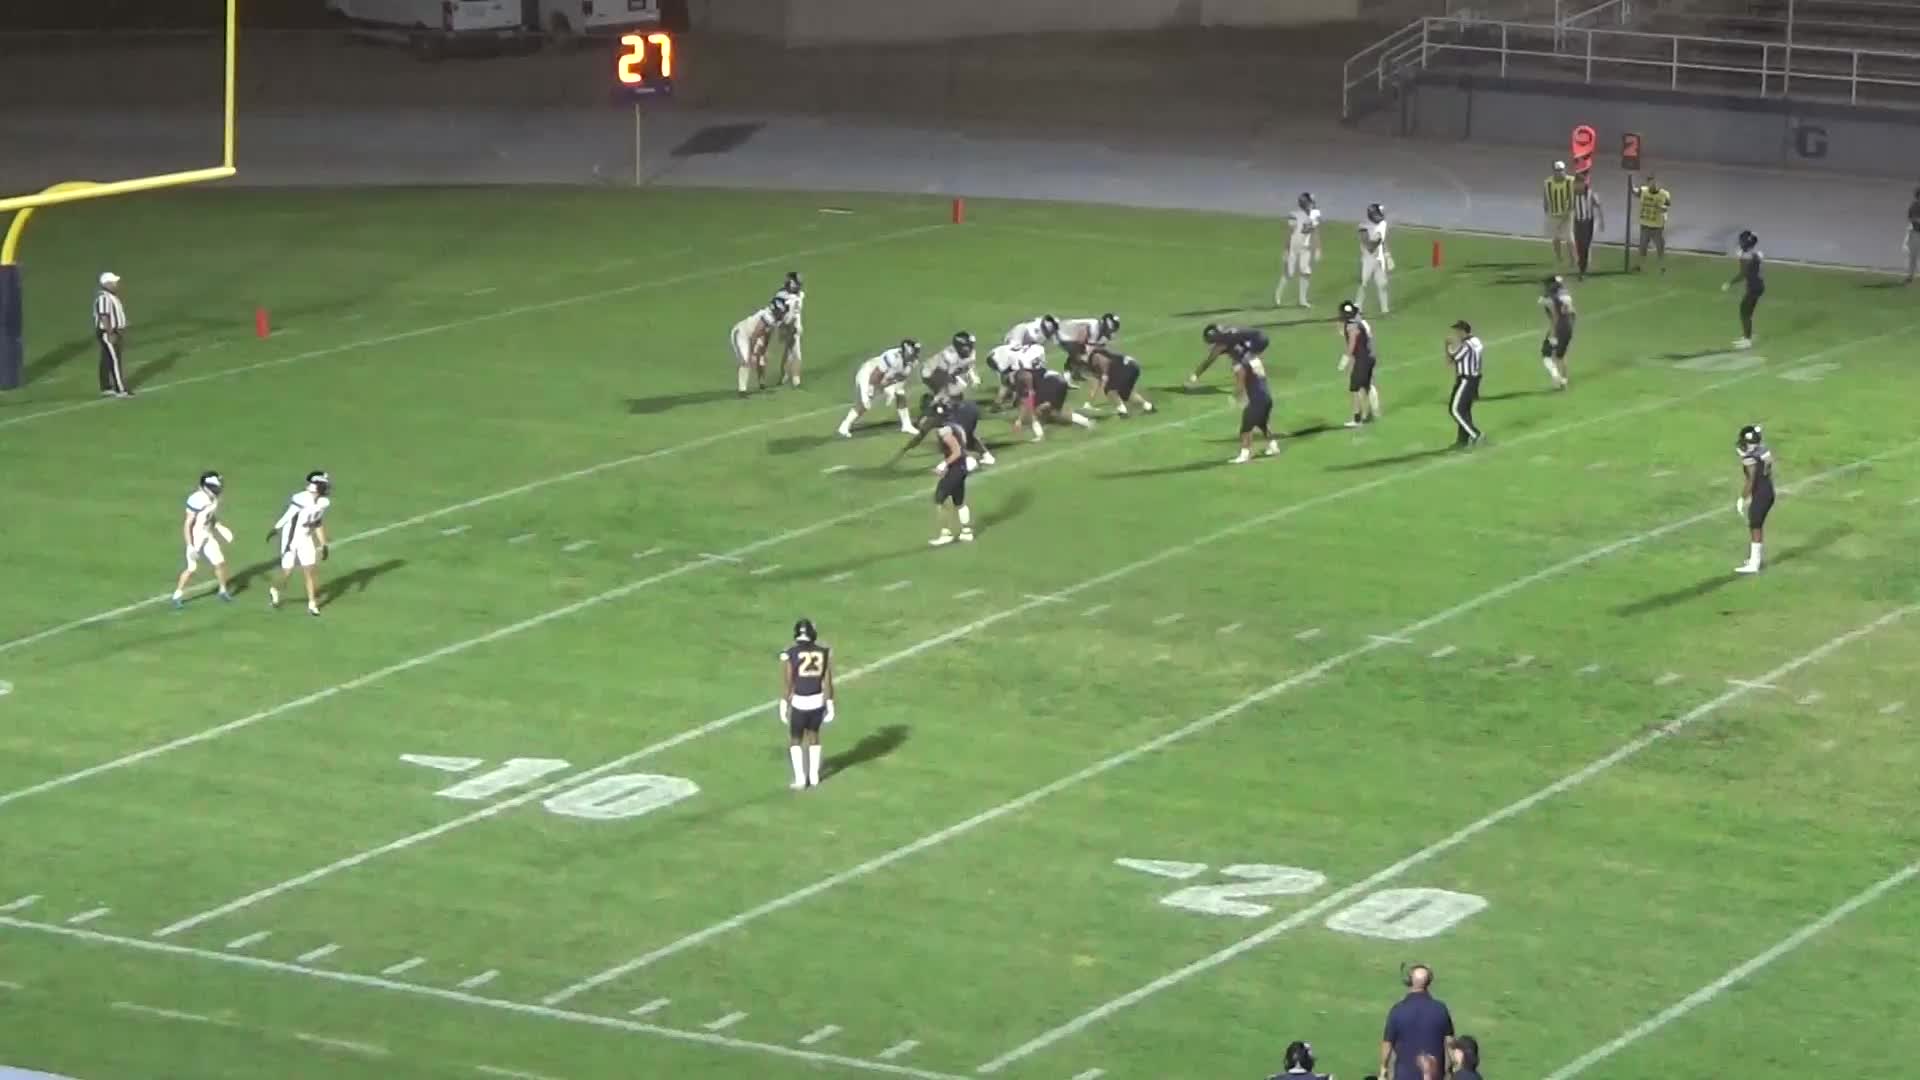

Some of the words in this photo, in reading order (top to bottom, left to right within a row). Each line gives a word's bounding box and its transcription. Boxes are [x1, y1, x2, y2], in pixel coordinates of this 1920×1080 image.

[618, 33, 671, 83] 27
[1624, 135, 1639, 157] 2
[1796, 125, 1829, 159] G
[797, 651, 824, 677] 23
[435, 757, 699, 820] 10
[1159, 863, 1489, 941] 20
